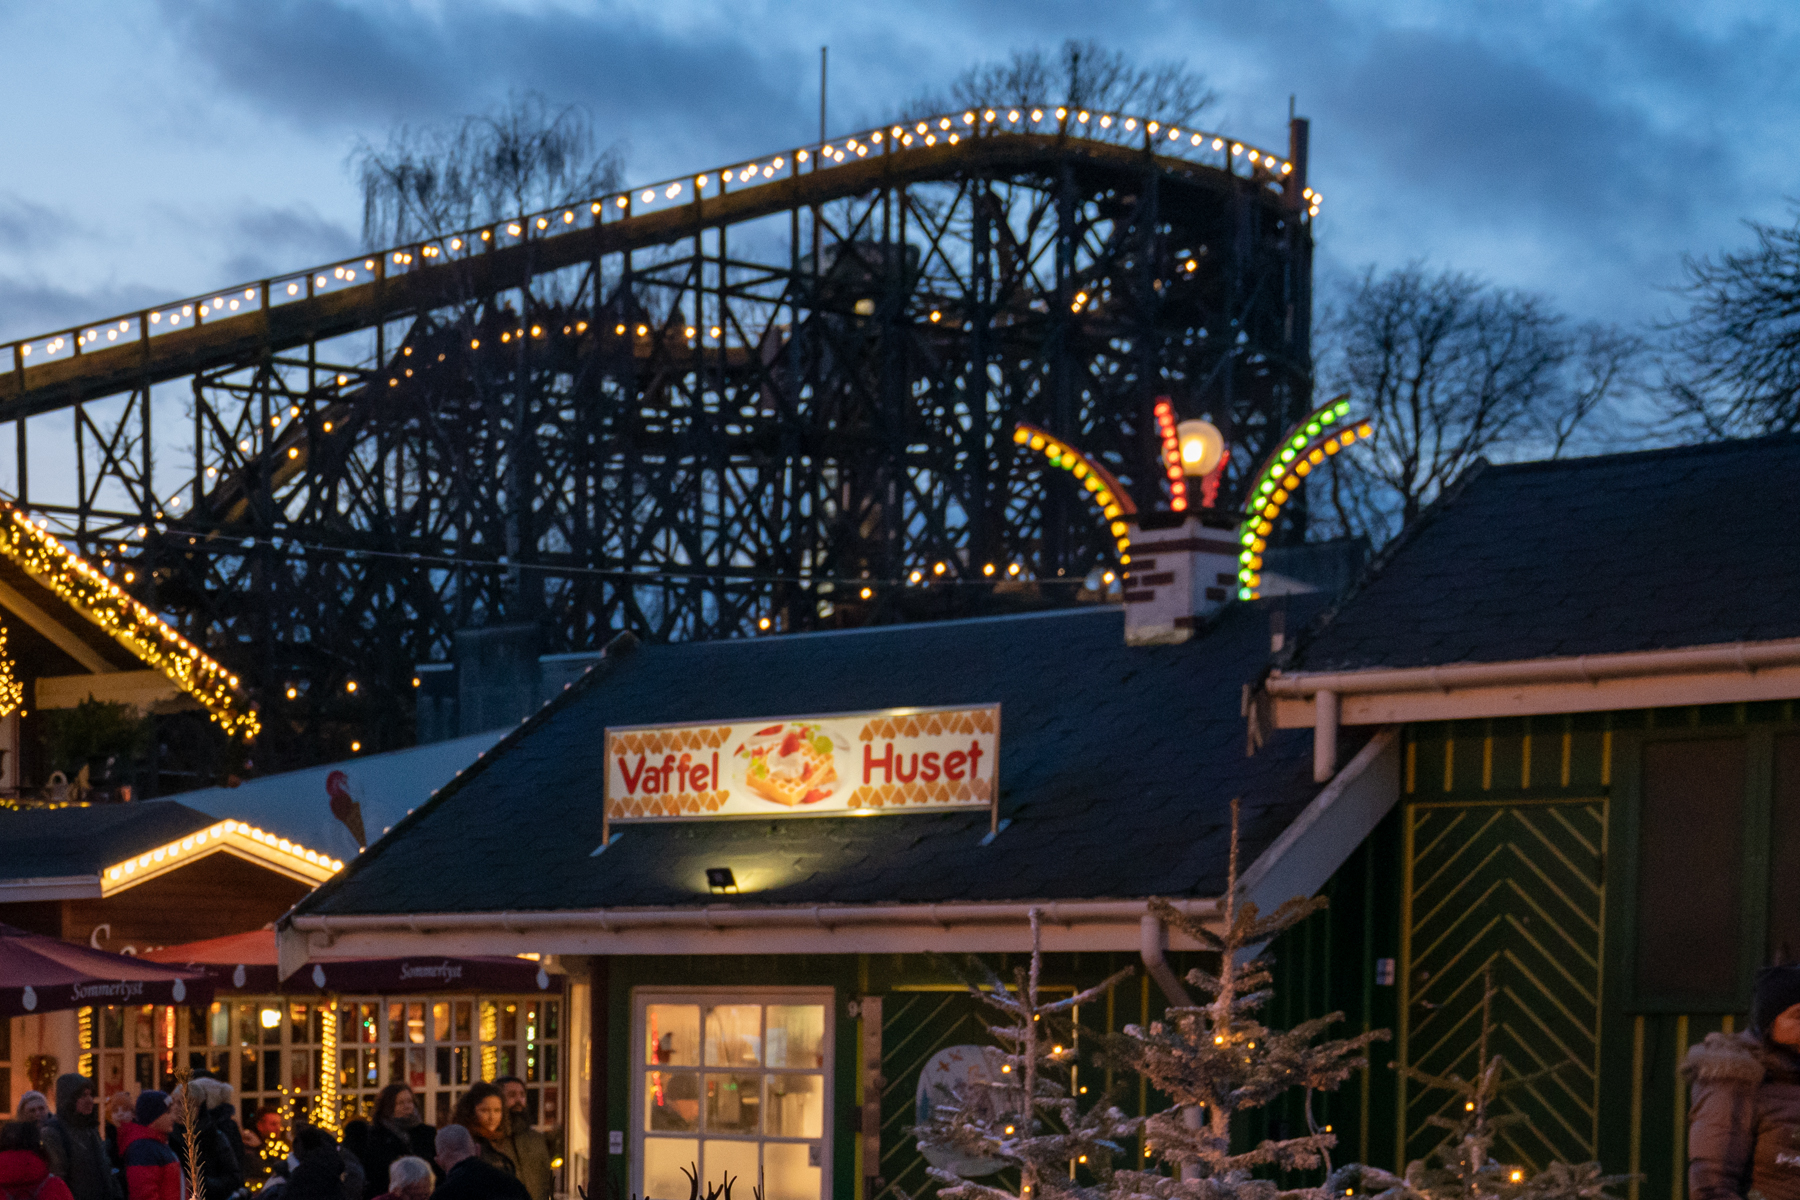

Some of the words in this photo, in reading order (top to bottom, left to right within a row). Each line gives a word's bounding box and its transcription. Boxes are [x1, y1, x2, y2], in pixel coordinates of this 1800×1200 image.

[618, 751, 720, 796] Vaffel
[862, 739, 984, 785] Huset
[70, 977, 144, 1001] Sommerlyst
